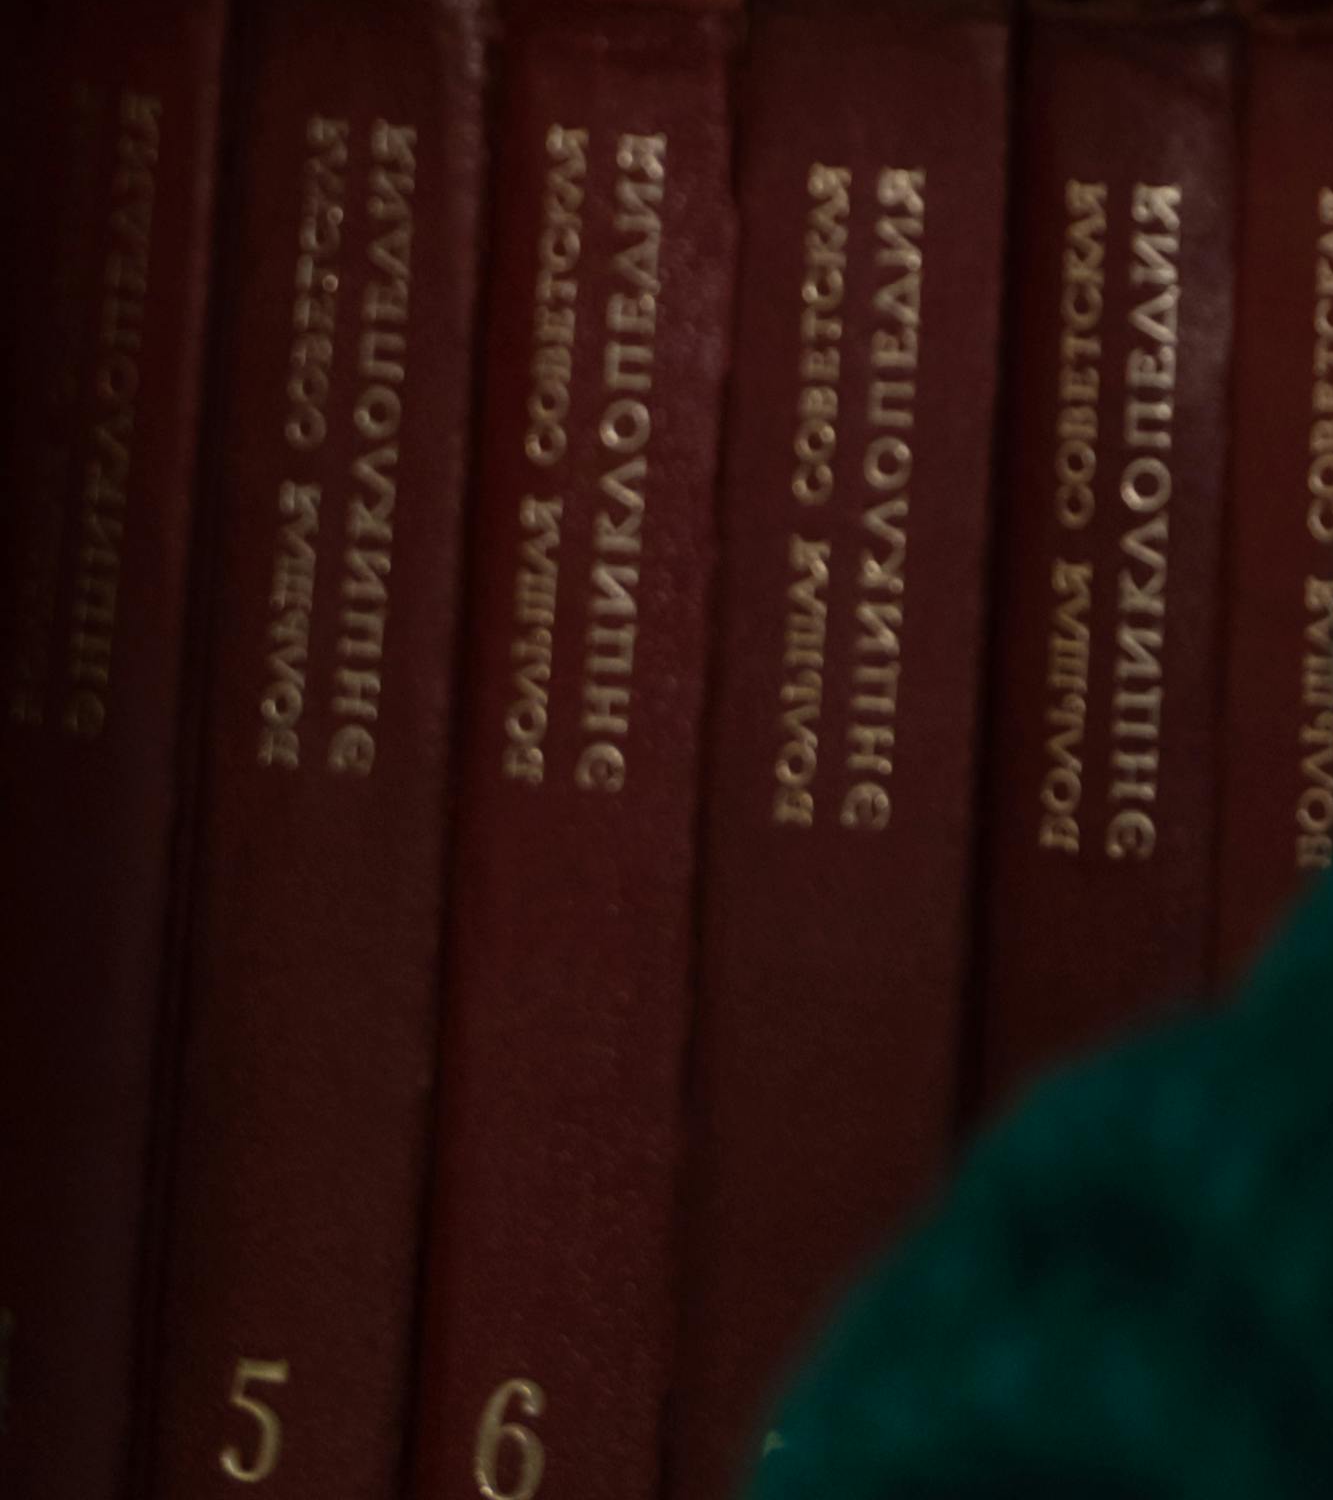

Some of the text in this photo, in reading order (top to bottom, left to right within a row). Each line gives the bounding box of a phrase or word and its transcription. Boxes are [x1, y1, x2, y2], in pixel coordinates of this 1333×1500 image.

[774, 162, 852, 828] БОЛЬШАЯ СОВЕТСКАЯ
[839, 166, 926, 833] ЭНЦИКЛОПЕДИЯ
[1039, 179, 1108, 855] БОЛЬШАЯ СОВЕТСКАЯ
[1105, 181, 1182, 862] ЭНЦИКЛОПЕДИЯ
[218, 1355, 292, 1487] 5
[473, 1376, 548, 1500] 6
